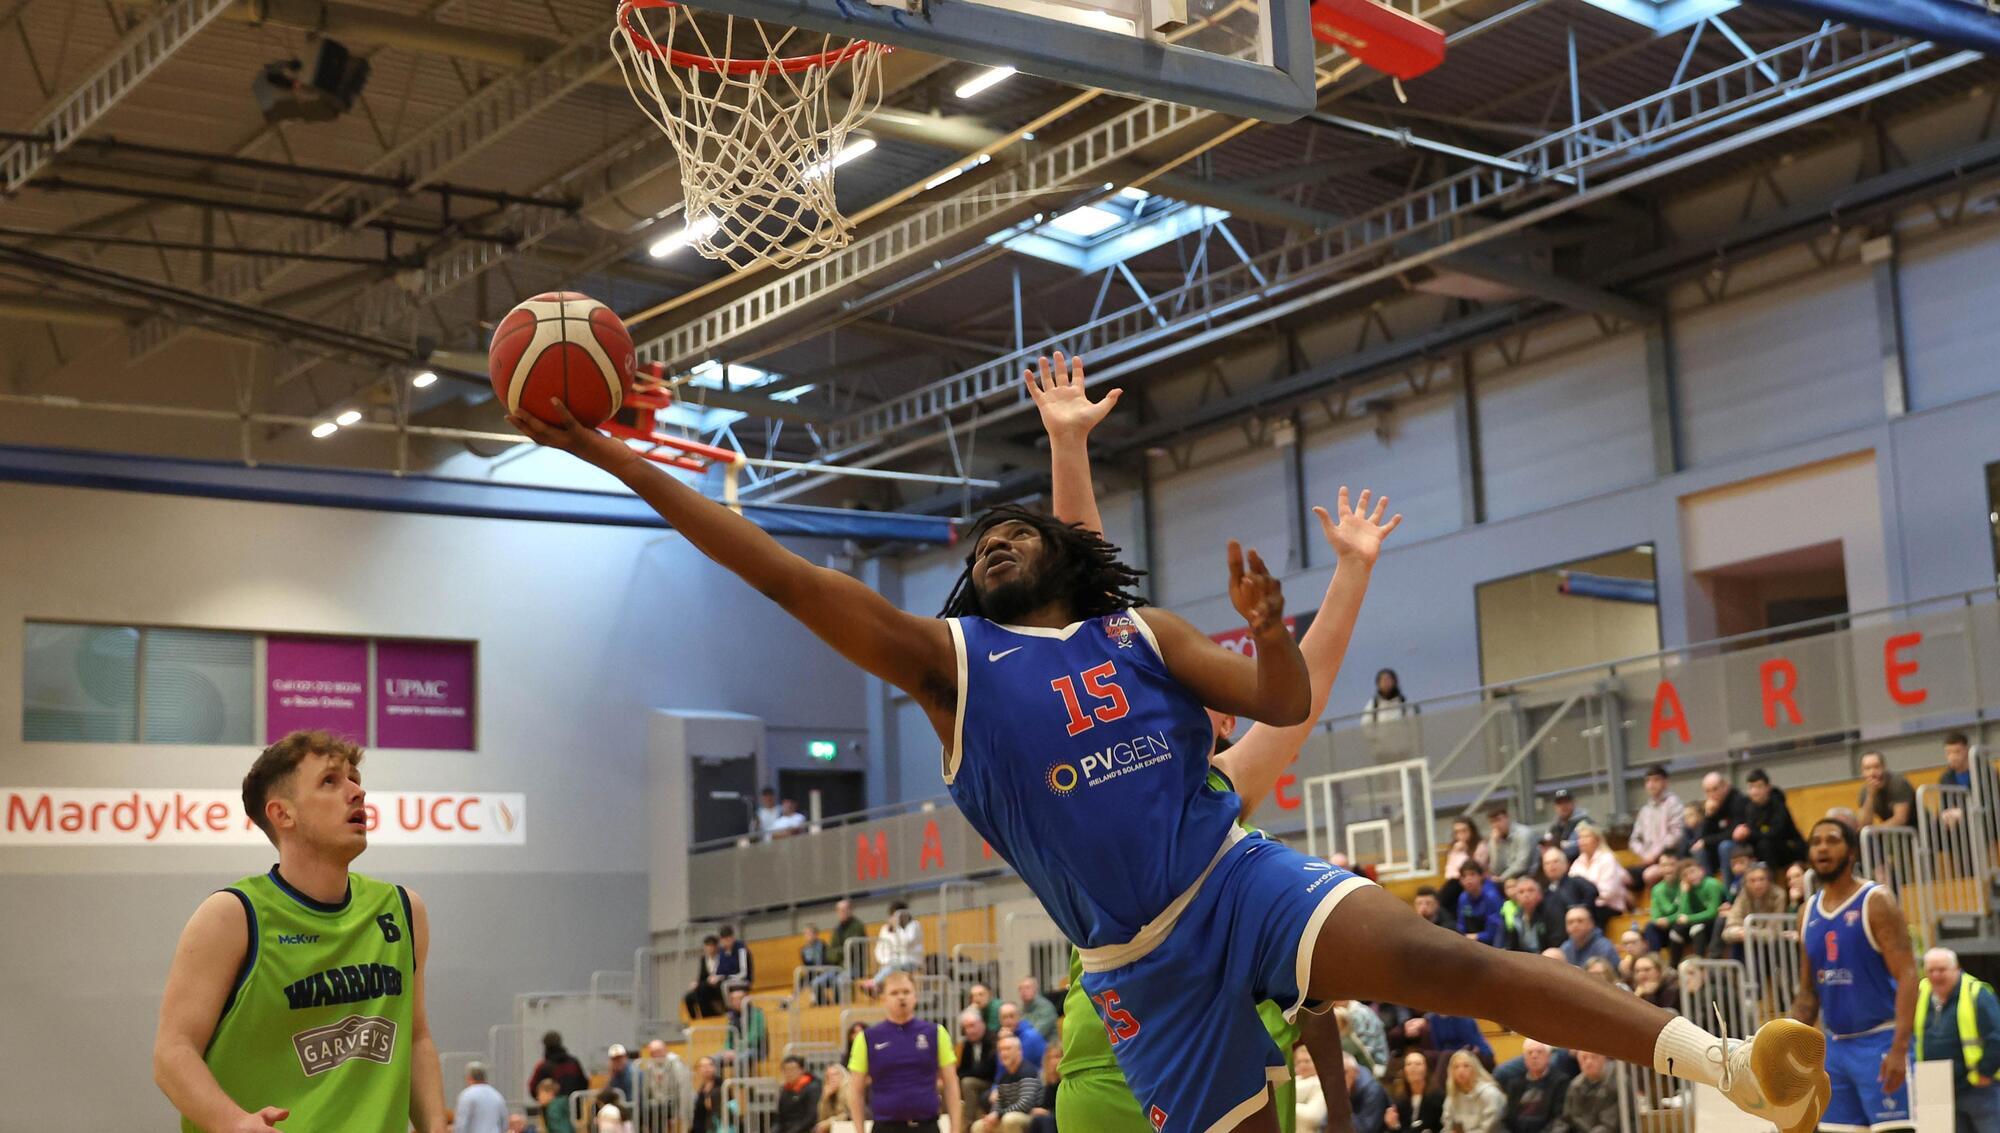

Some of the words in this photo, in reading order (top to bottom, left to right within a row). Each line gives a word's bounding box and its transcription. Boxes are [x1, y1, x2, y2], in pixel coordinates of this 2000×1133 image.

[385, 678, 448, 699] UPMC
[1051, 660, 1130, 737] 15
[1080, 731, 1169, 779] PVGEN
[1088, 768, 1122, 787] IRELAND'S
[1122, 763, 1144, 775] SOLAR
[1145, 753, 1172, 767] EXPERTS
[7, 791, 230, 840] Mardyke
[397, 796, 481, 832] UCC
[376, 912, 401, 943] 6
[304, 1029, 389, 1063] GARVEY'S
